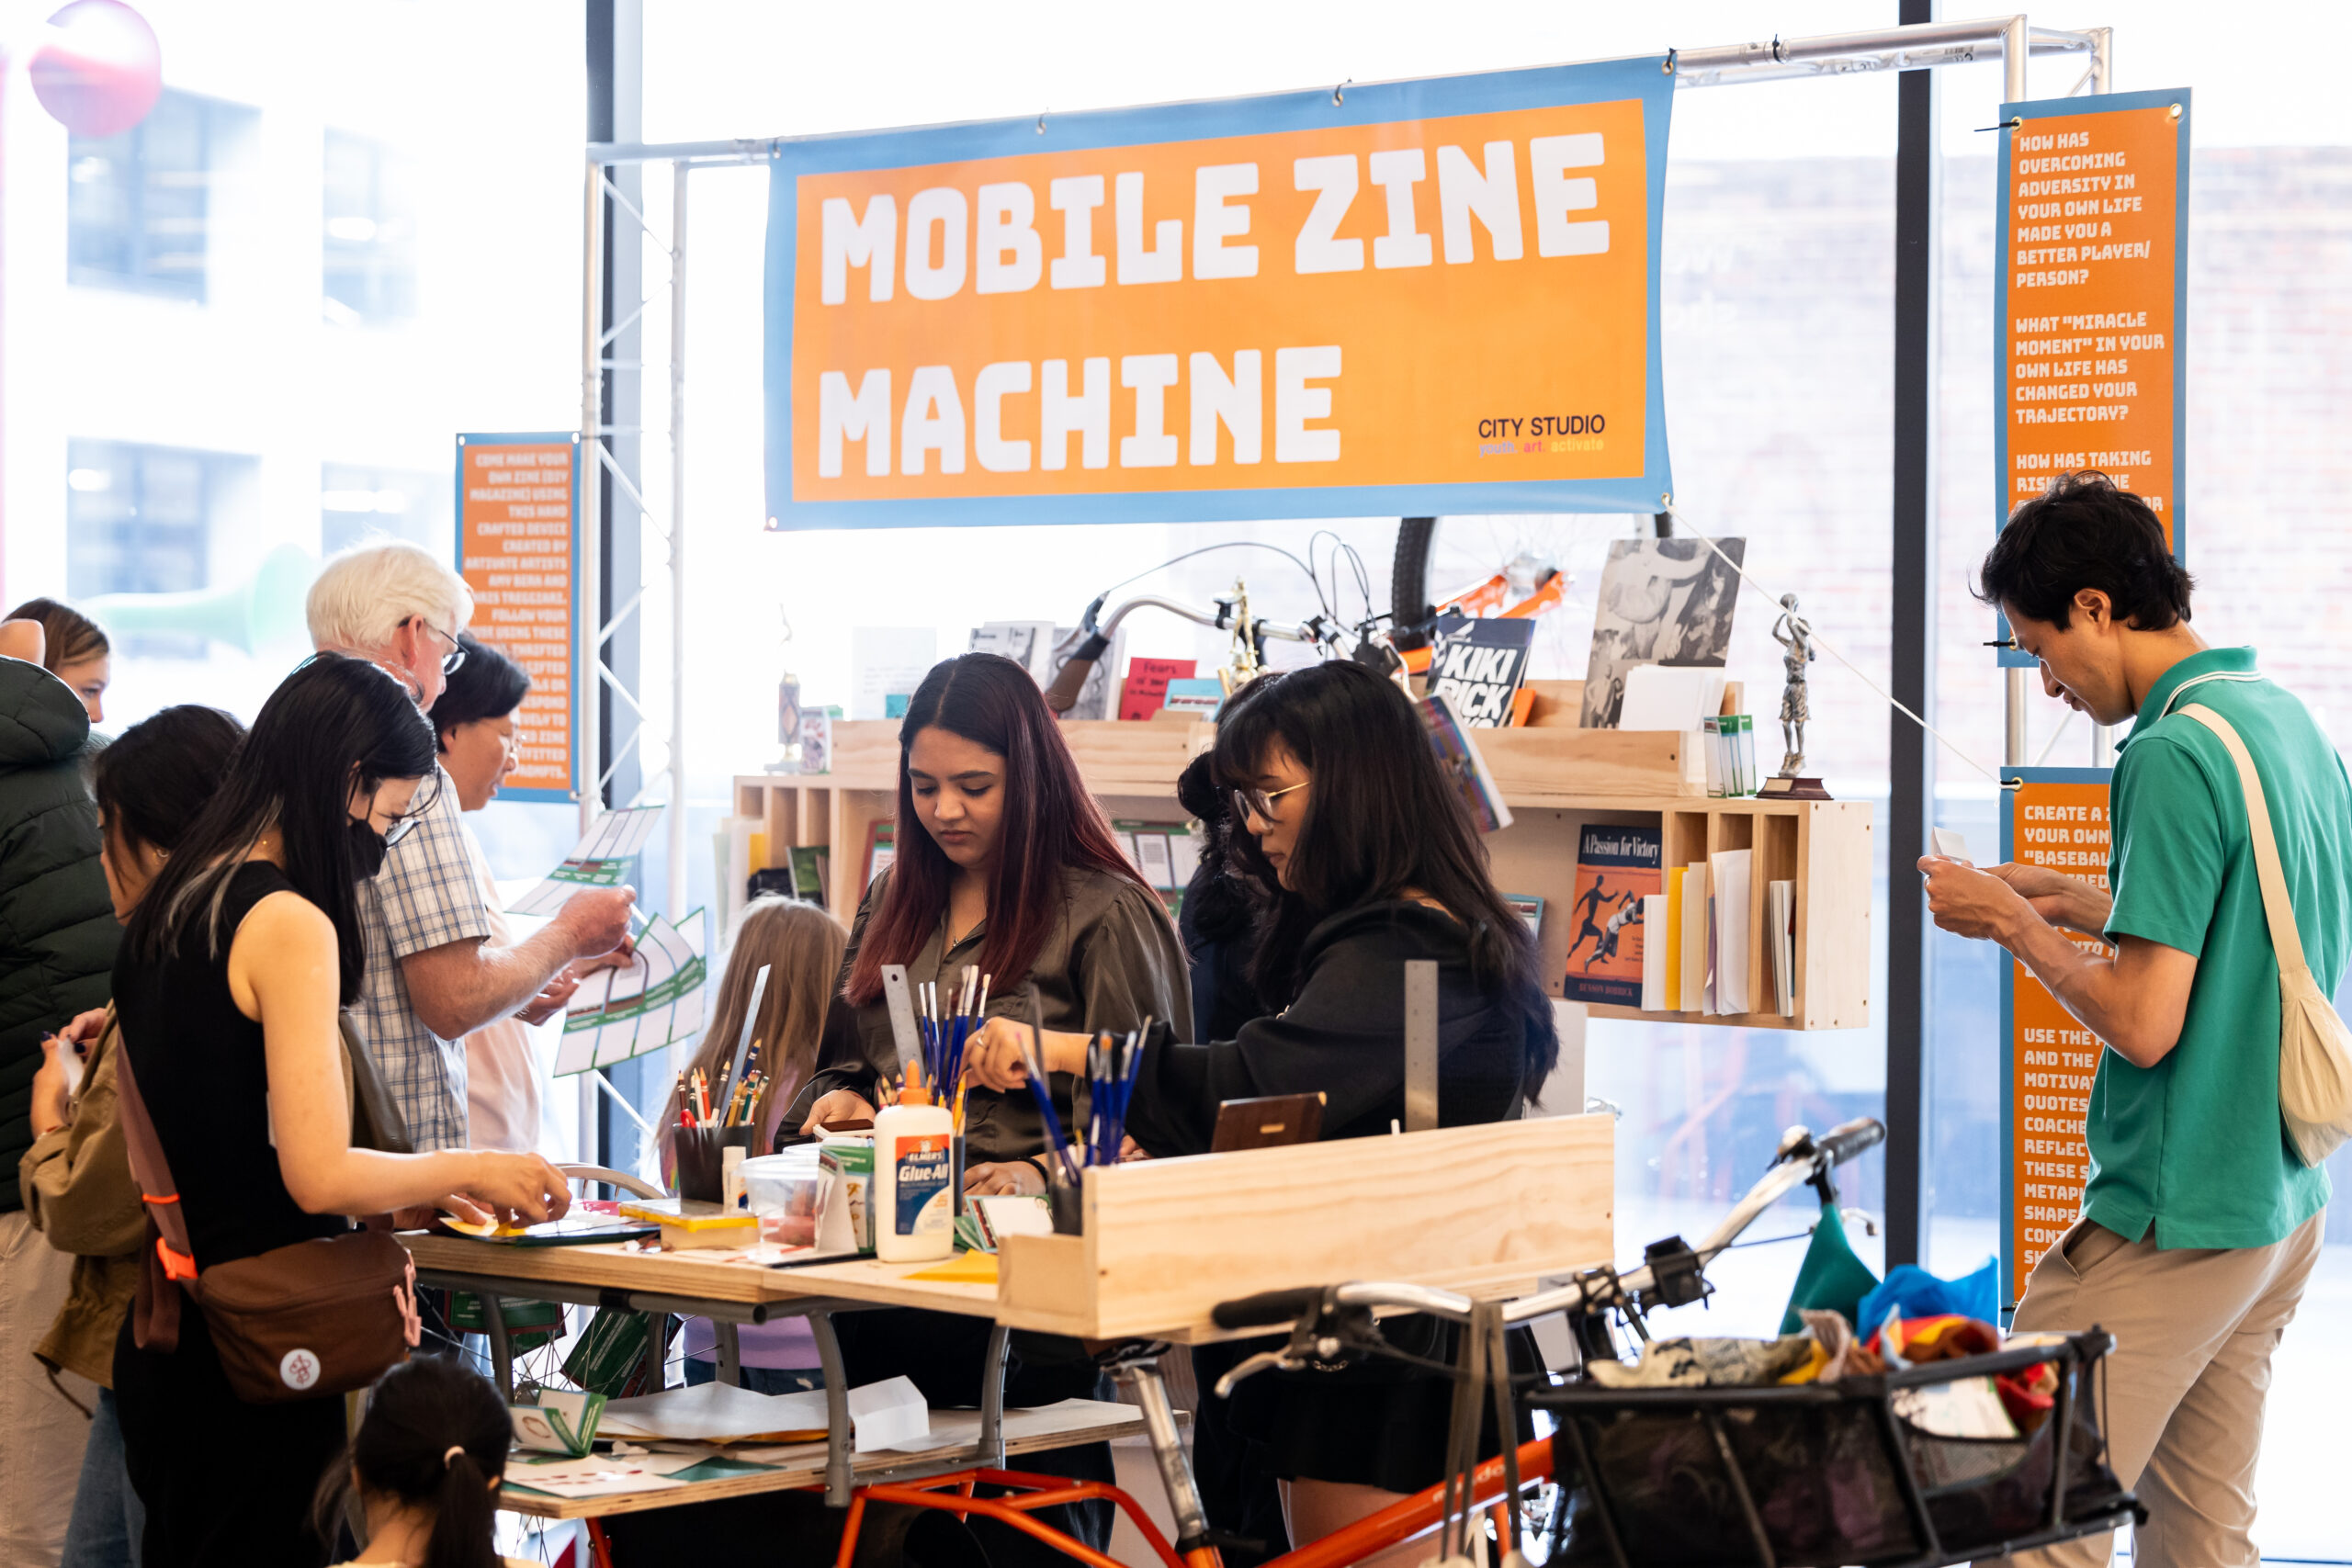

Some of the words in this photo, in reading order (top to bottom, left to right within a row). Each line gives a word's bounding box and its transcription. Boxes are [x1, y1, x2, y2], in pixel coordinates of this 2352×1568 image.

[2019, 135, 2053, 152] HOW
[2057, 131, 2089, 150] HAS
[2019, 152, 2126, 175] OVERCOMING
[2018, 175, 2111, 197] ADVERSITY
[2114, 174, 2135, 190] IN
[820, 162, 1260, 306] MOBILE
[1294, 131, 1610, 275] ZINE
[2018, 202, 2061, 220] YOUR
[2064, 199, 2099, 216] OWN
[2103, 197, 2143, 214] LIFE
[2018, 225, 2062, 243] MADE
[2064, 223, 2098, 240] YOU
[2100, 221, 2112, 237] A
[2017, 247, 2077, 265] BETTER
[2081, 241, 2151, 261] PLAYER/
[2017, 269, 2089, 288] PERSON?
[2016, 317, 2060, 333] WHAT
[2063, 311, 2147, 331] "MIRACLE
[2016, 337, 2092, 355] MOMENT"
[2096, 336, 2116, 352] IN
[2120, 333, 2165, 351] YOUR
[2016, 363, 2050, 378] OWN
[2053, 360, 2092, 378] LIFE
[2095, 359, 2128, 375] HAS
[2016, 384, 2089, 401] CHANGED
[2093, 381, 2138, 398] YOUR
[819, 344, 1342, 478] MACHINE
[2016, 405, 2129, 423] TRAJECTORY?
[1478, 416, 1523, 438] CITY
[1531, 413, 1605, 436] STUDIO
[1523, 441, 1545, 453] art.
[1551, 437, 1604, 452] activate
[2016, 454, 2050, 469] HOW
[2053, 453, 2086, 468] HAS
[2088, 450, 2152, 467] TAKING
[1441, 644, 1518, 683] KIKI
[2024, 805, 2087, 821] CREATE
[2090, 807, 2102, 821] A
[2024, 828, 2070, 843] YOUR
[2073, 829, 2110, 844] OWN
[1582, 834, 1589, 853] A
[1589, 834, 1619, 855] Passion
[1620, 835, 1632, 856] for
[1633, 836, 1659, 864] Victory
[2024, 1028, 2056, 1043] USE
[2059, 1030, 2092, 1045] THE
[2024, 1050, 2058, 1066] AND
[2062, 1052, 2094, 1067] THE
[2024, 1094, 2088, 1112] QUOTES
[2024, 1161, 2075, 1179] THESE
